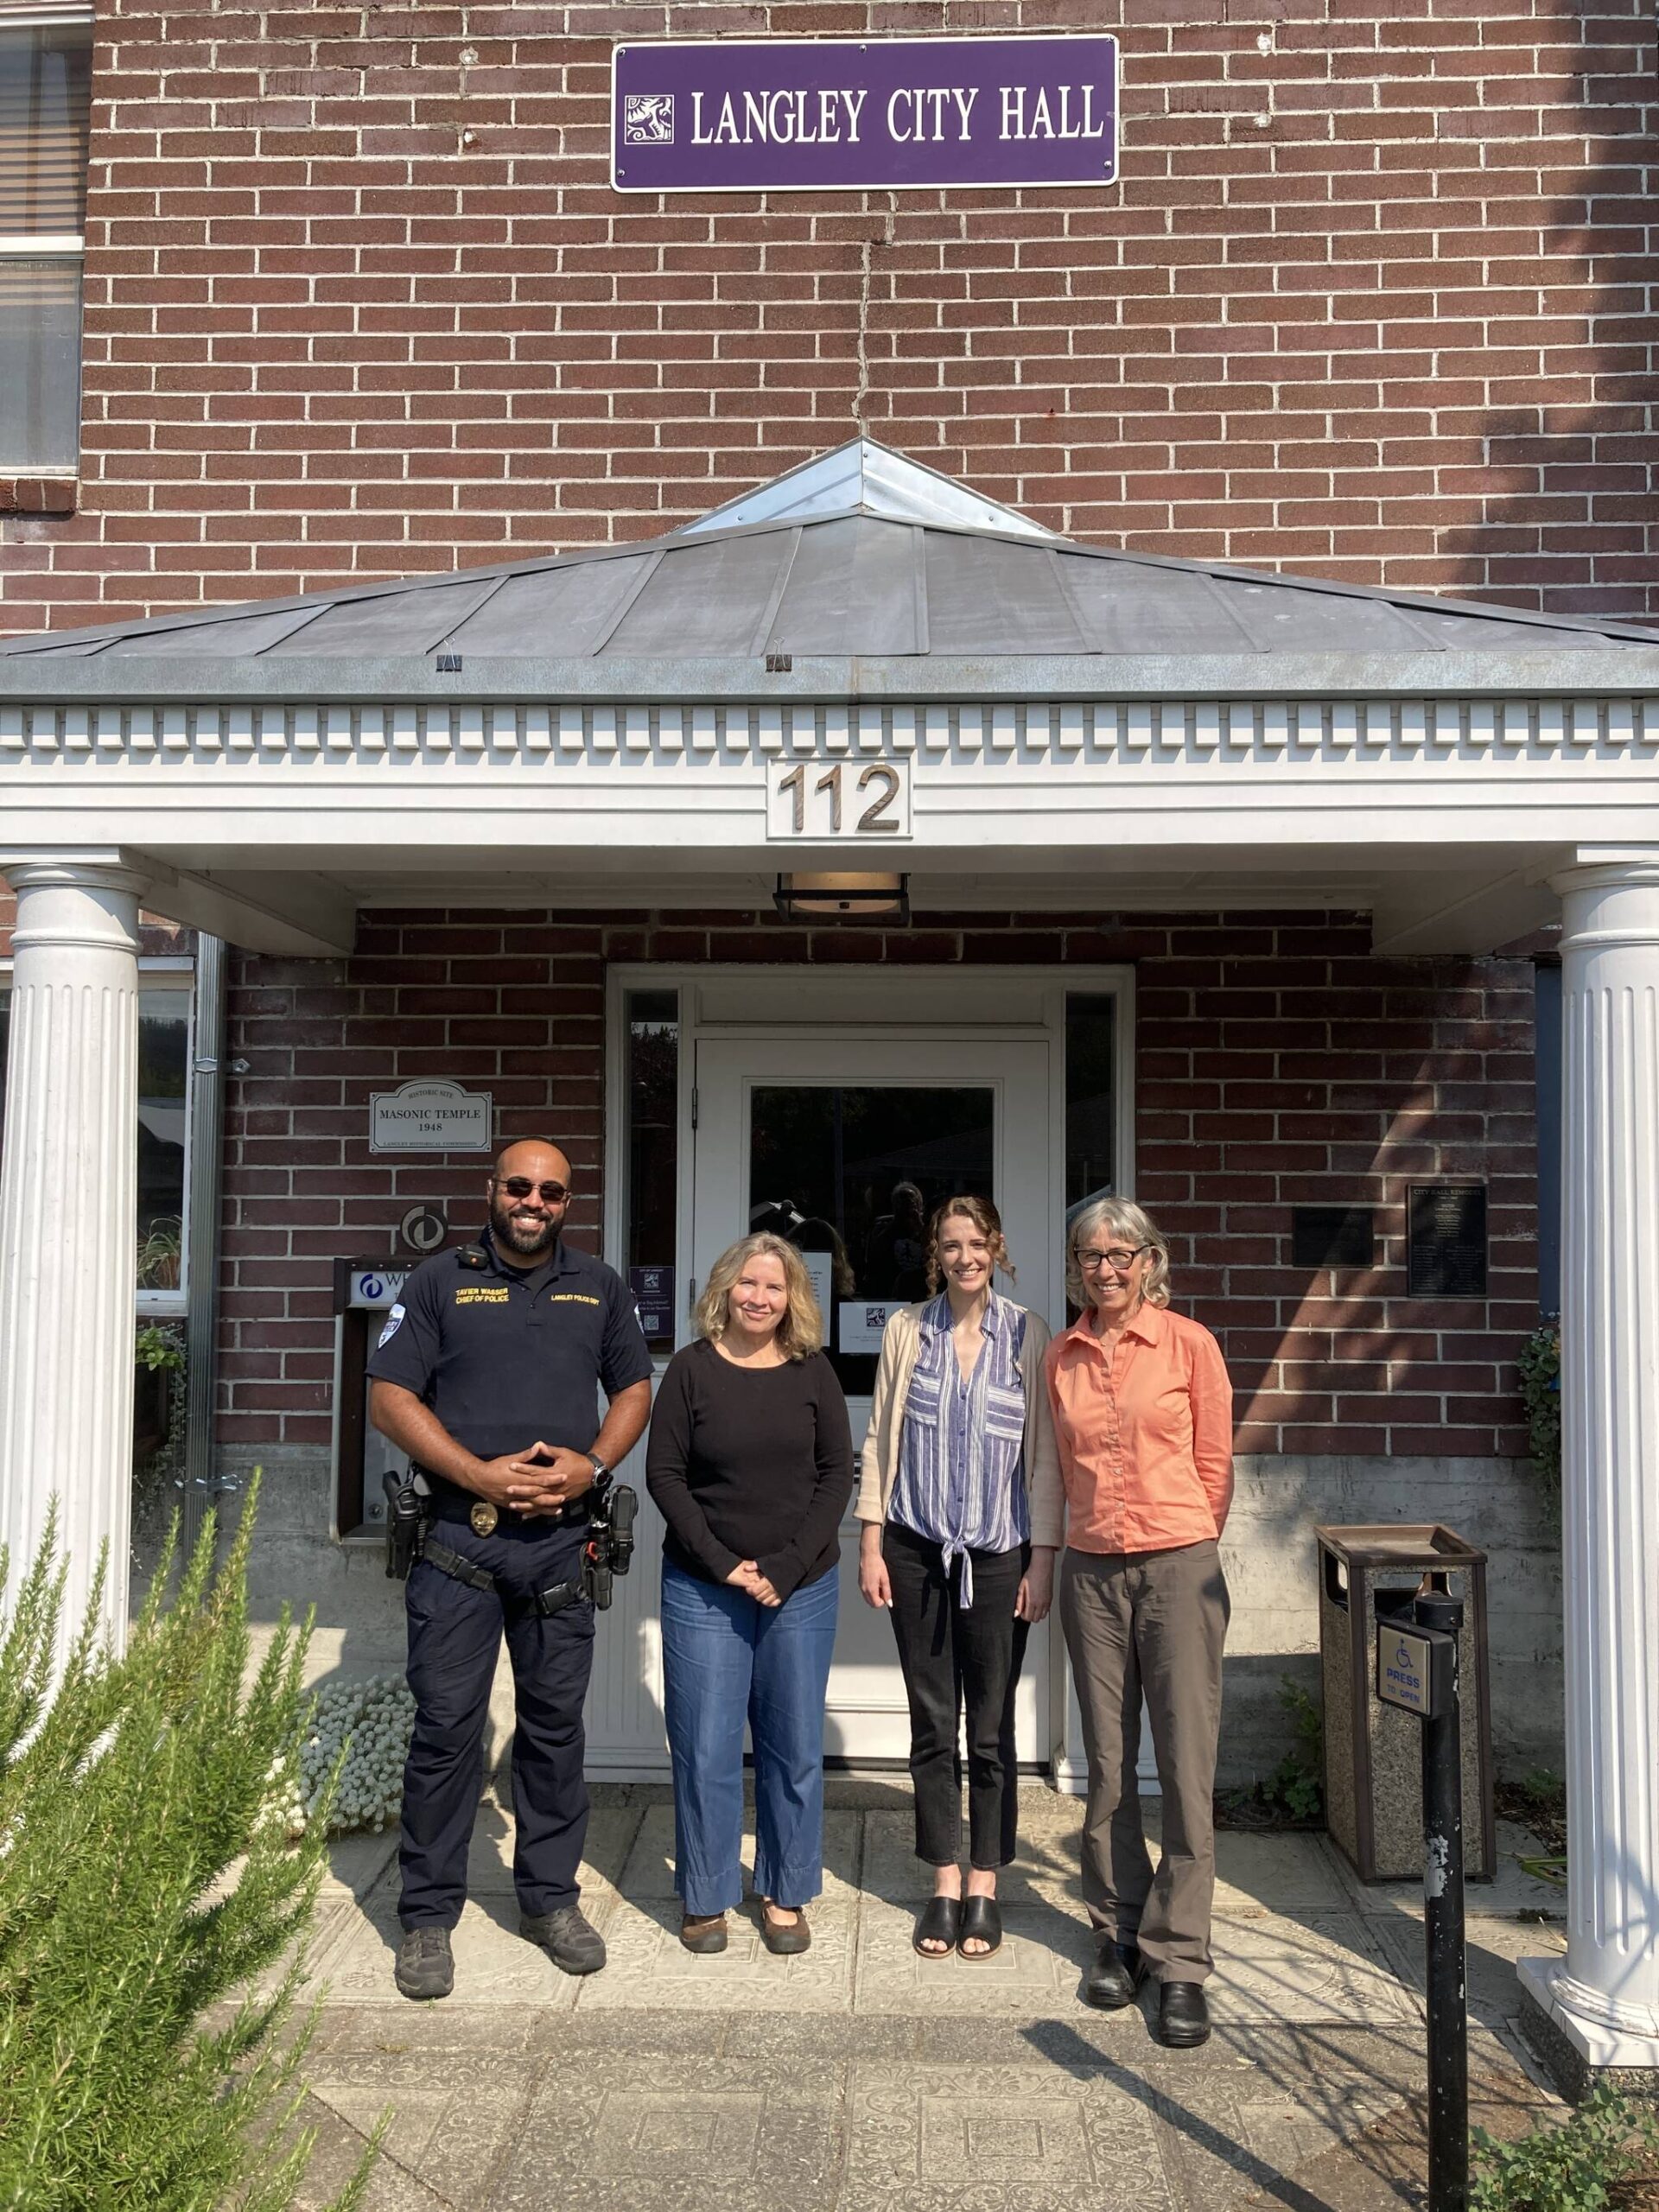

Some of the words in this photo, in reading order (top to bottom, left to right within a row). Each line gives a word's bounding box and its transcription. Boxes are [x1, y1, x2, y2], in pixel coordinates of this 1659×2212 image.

[690, 89, 868, 144] LANGLEY
[887, 87, 979, 143] CITY
[998, 85, 1104, 140] HALL
[780, 764, 900, 830] 112
[408, 1090, 438, 1099] HISTORIC
[439, 1090, 454, 1099] SITE
[380, 1109, 432, 1119] MASONIC
[435, 1109, 481, 1119] TEMPLE
[419, 1123, 442, 1132] 1948
[455, 1287, 480, 1296] TAVIER
[455, 1295, 474, 1304] CHIEF
[484, 1294, 510, 1303] POLICE
[1387, 1668, 1420, 1688] PRESS
[1387, 1684, 1396, 1694] TO
[1400, 1691, 1420, 1703] OPEN
